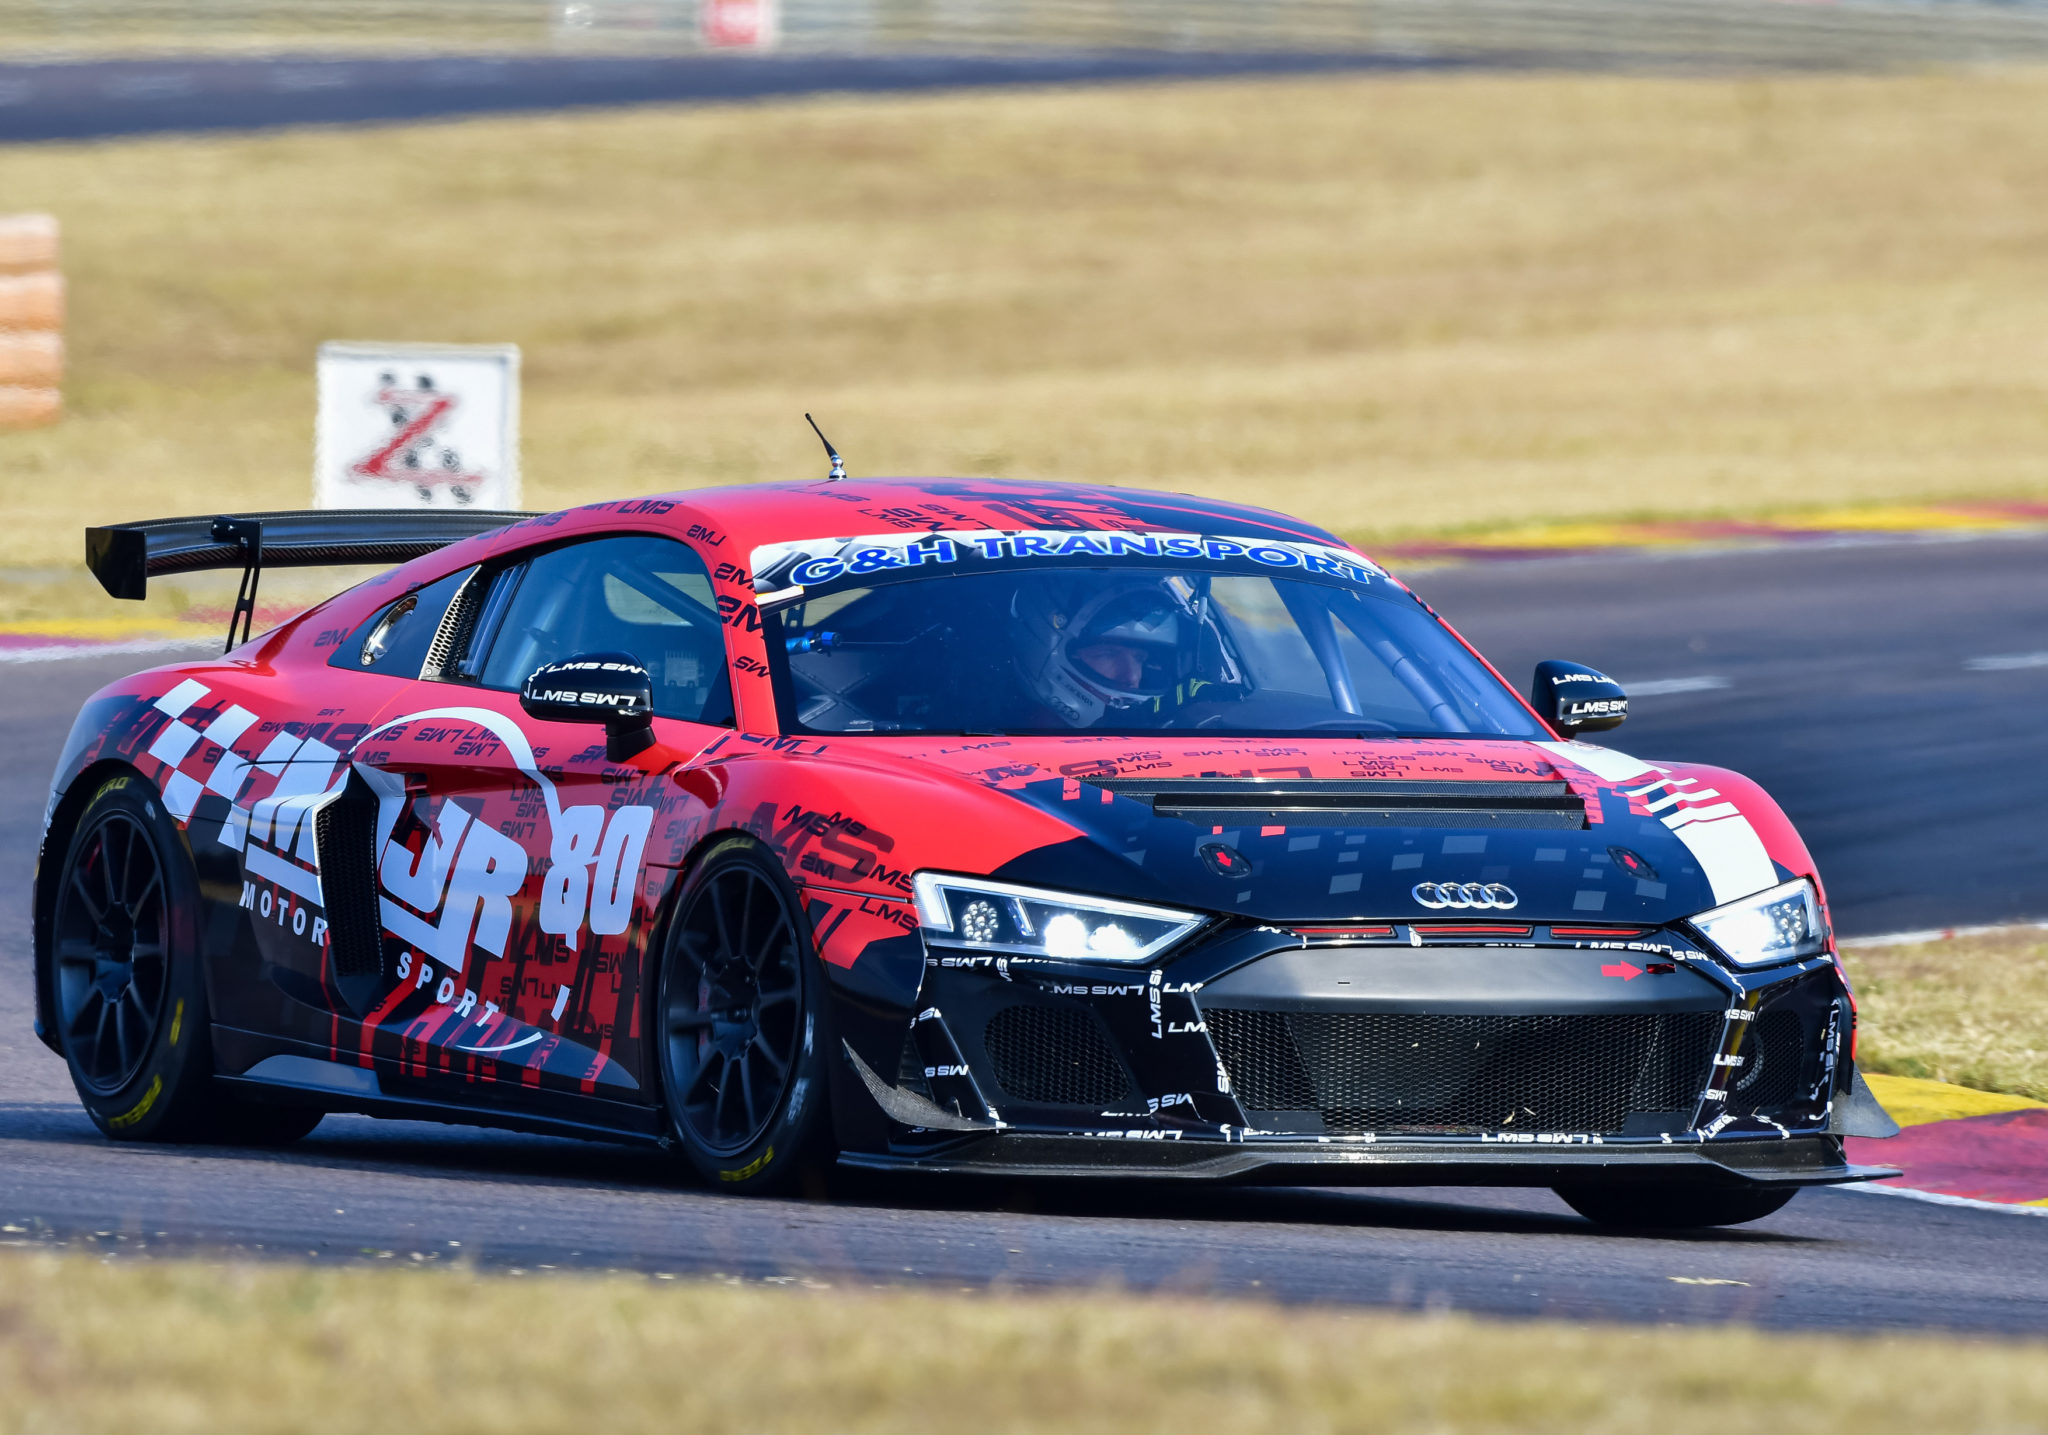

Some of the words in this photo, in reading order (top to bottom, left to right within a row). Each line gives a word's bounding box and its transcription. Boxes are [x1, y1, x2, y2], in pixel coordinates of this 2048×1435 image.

[617, 500, 682, 514] LMS
[790, 537, 957, 587] G&H
[974, 533, 1375, 586] TRANSPORT
[546, 662, 600, 674] LMS
[1552, 674, 1592, 686] LMS
[1592, 675, 1620, 687] LM
[531, 690, 580, 703] LMS
[1571, 702, 1610, 714] LMS
[529, 746, 550, 759] MS
[534, 765, 565, 782] MS
[1119, 761, 1173, 773] LMS
[539, 804, 655, 937] 80
[851, 857, 913, 893] LMS
[238, 880, 328, 947] MOTOR
[859, 896, 920, 932] LMS
[396, 951, 500, 1027] SPORT
[1050, 985, 1088, 995] MS
[1162, 982, 1203, 993] LM
[1150, 987, 1163, 1040] LMS
[1168, 1021, 1209, 1033] LM
[936, 1064, 969, 1077] MS
